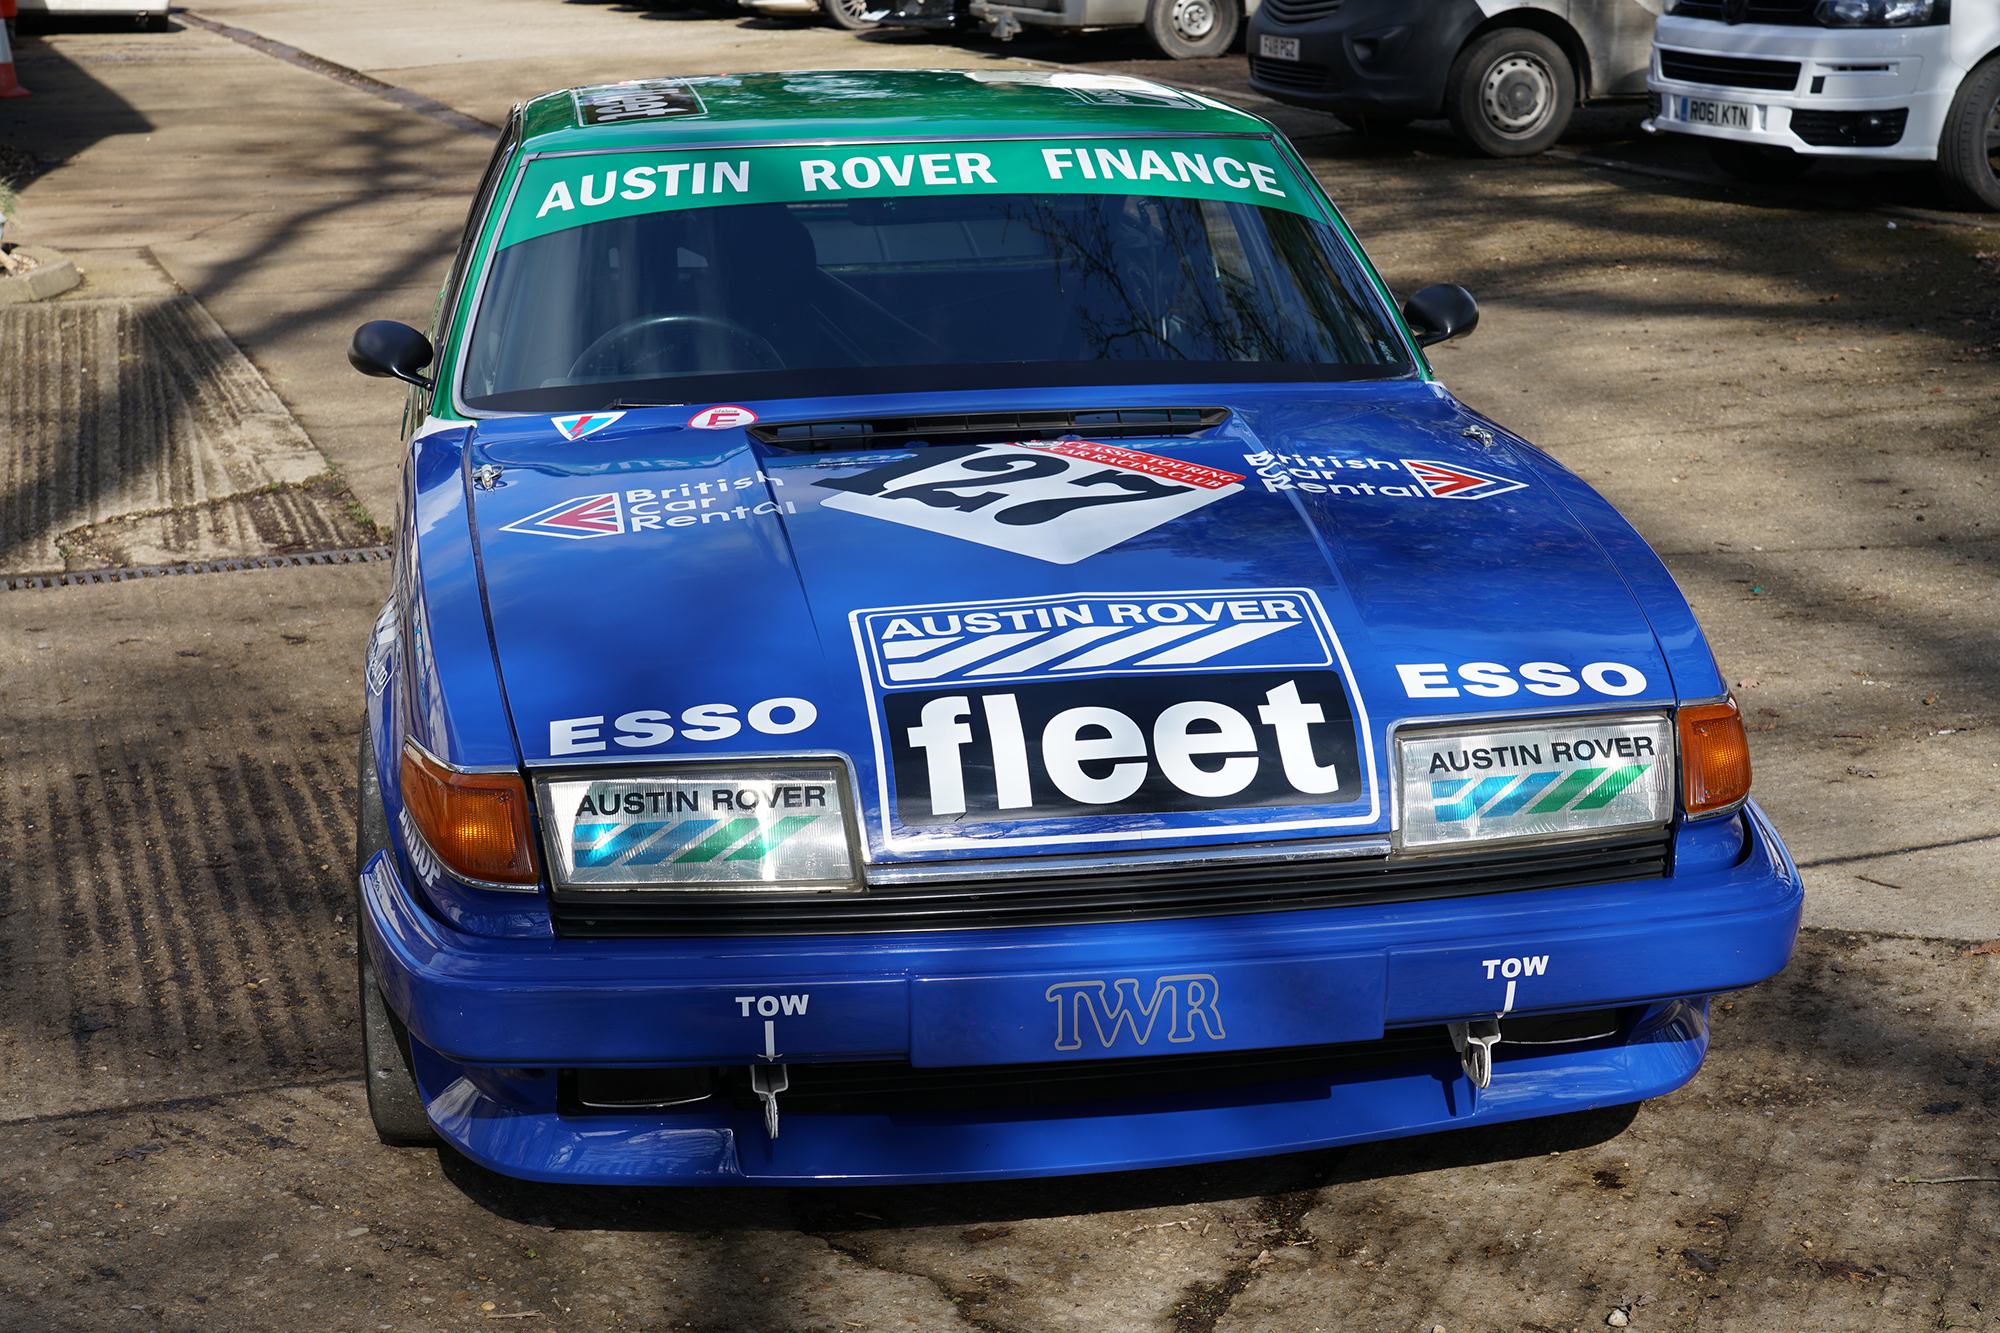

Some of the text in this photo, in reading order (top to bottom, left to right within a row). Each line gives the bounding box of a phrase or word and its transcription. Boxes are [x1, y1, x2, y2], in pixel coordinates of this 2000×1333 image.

[1722, 105, 1748, 127] KTN
[536, 148, 1286, 219] AUSTIN ROVER FINANCE
[1050, 445, 1224, 489] CAR RACING CLUB
[1064, 441, 1146, 461] CLASSIC
[1149, 457, 1238, 482] TOURING
[1243, 450, 1399, 471] British
[1256, 461, 1337, 481] Car
[626, 470, 785, 503] British
[1260, 474, 1425, 498] Rental
[629, 496, 718, 517] Car
[631, 500, 797, 533] Rental
[881, 599, 1303, 640] AUSTIN ROVER
[1395, 661, 1648, 698] ESSO
[549, 697, 818, 756] ESSO
[906, 679, 1340, 816] fleet
[1428, 735, 1656, 774] AUSTIN ROVER
[575, 785, 827, 817] AUSTIN ROVER
[1482, 955, 1550, 980] TOW
[735, 994, 809, 1017] TOW
[1045, 973, 1227, 1051] TWR
